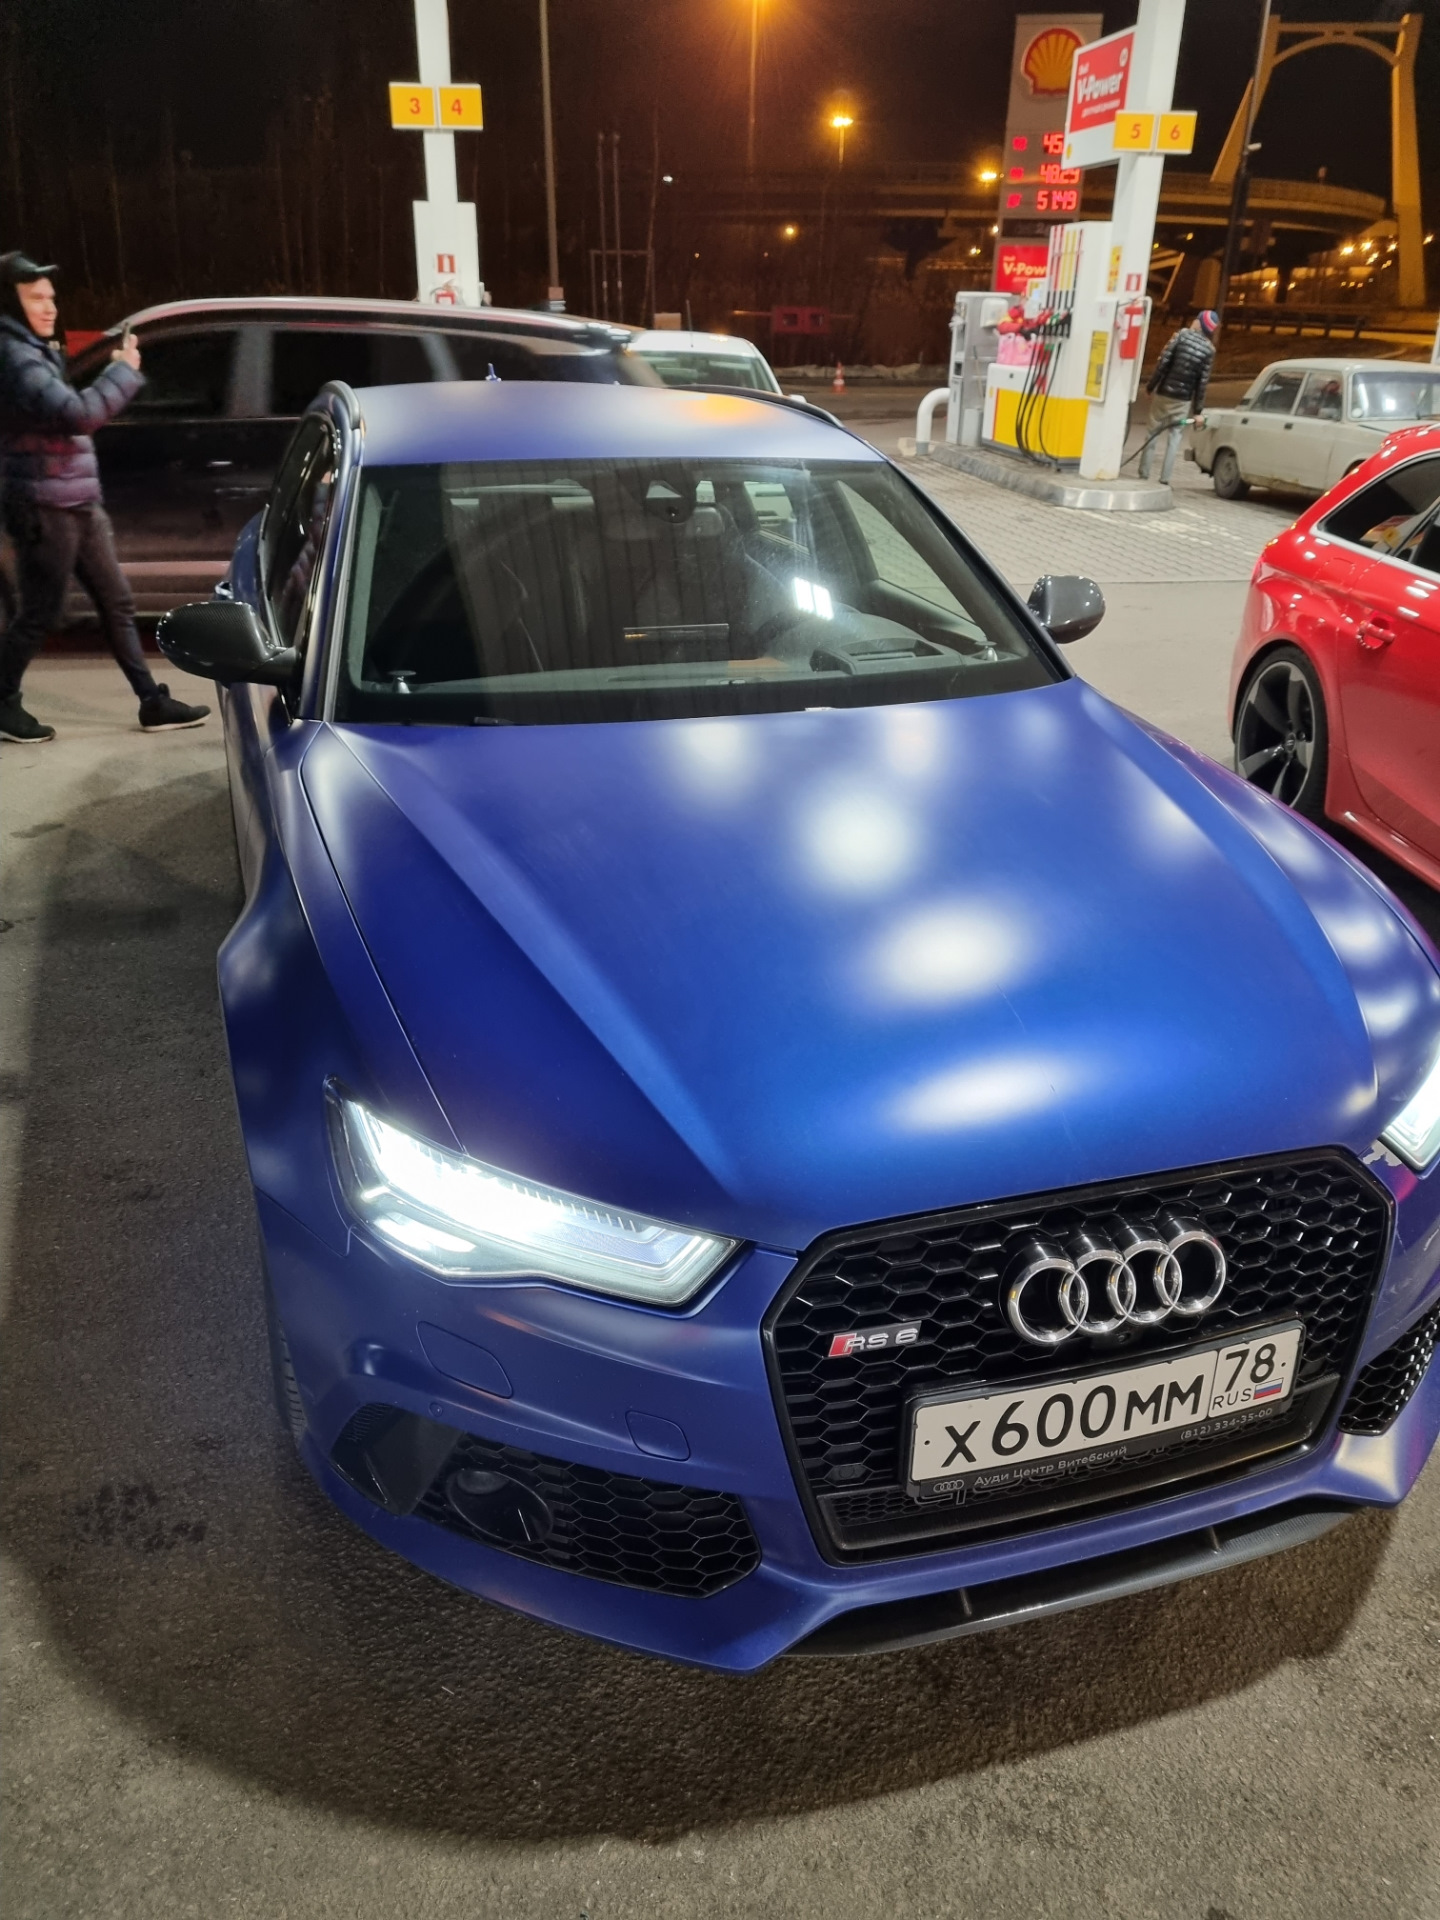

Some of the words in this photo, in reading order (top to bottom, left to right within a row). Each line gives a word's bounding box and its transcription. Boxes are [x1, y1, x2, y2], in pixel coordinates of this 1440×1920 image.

[1077, 72, 1124, 104] V-Power
[409, 97, 421, 115] 3
[451, 98, 463, 116] 4
[1130, 123, 1142, 140] 5
[1169, 123, 1181, 141] 6
[1225, 1342, 1277, 1393] 78
[1211, 1388, 1252, 1410] RUS
[1180, 1425, 1212, 1440] (812)
[1214, 1408, 1273, 1431] 334-35-00
[974, 1473, 1009, 1487] Ауди
[1013, 1464, 1054, 1480] Центр
[1057, 1445, 1127, 1470] Витебский
